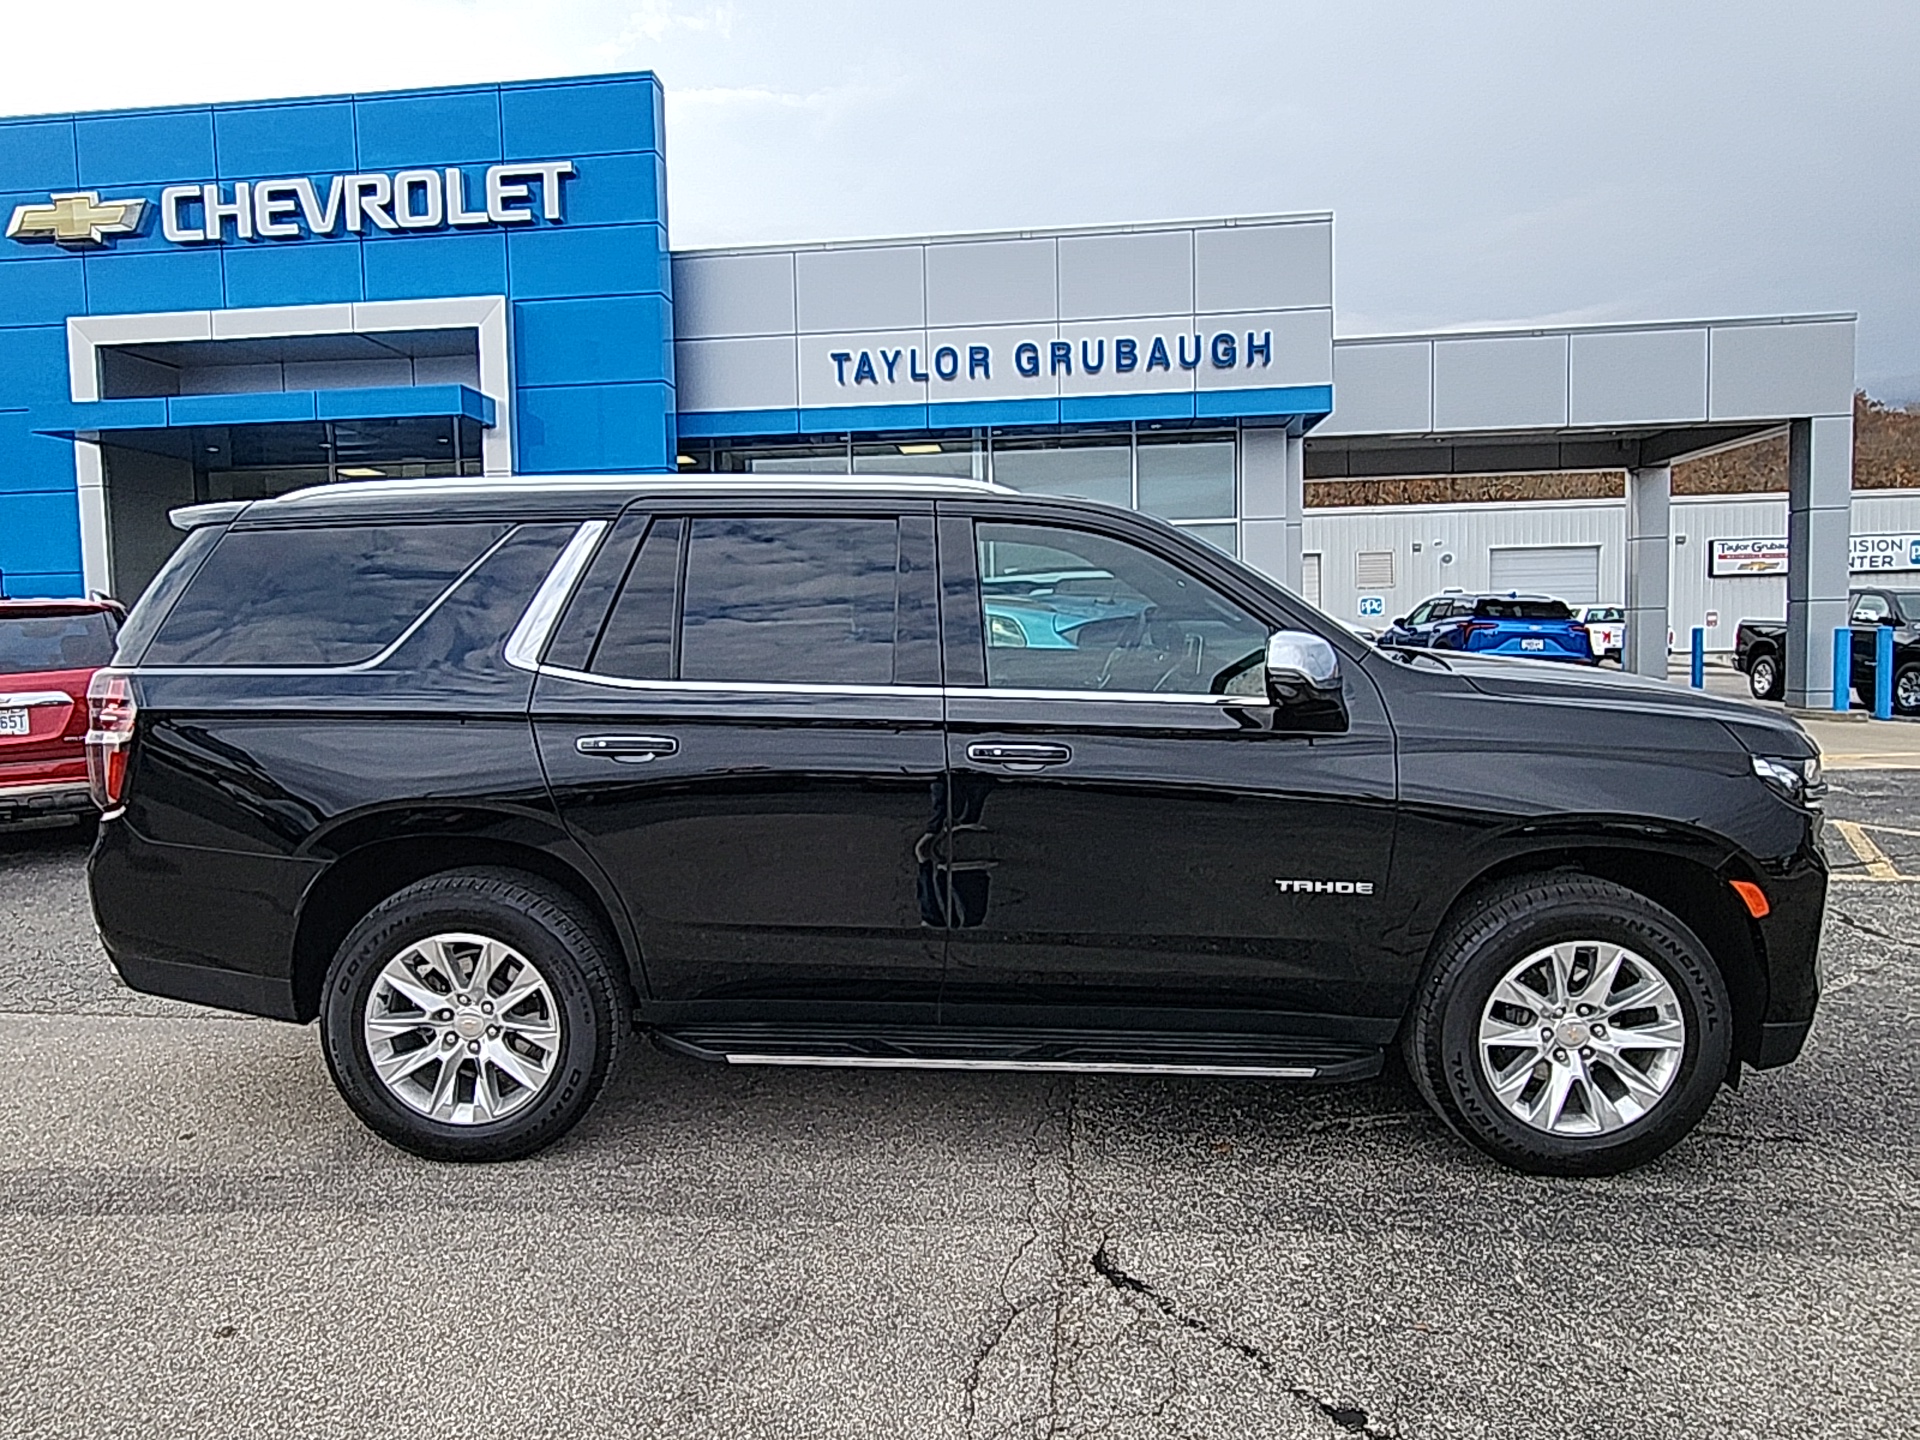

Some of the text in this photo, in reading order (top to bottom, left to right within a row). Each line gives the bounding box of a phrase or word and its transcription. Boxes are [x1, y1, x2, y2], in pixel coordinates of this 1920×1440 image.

[162, 160, 575, 244] CHEVROLET
[830, 331, 1272, 385] TAYLOR GRUBAUGH
[1718, 542, 1750, 553] Taylor
[1849, 538, 1903, 552] ISION
[1275, 879, 1374, 895] TAHOE
